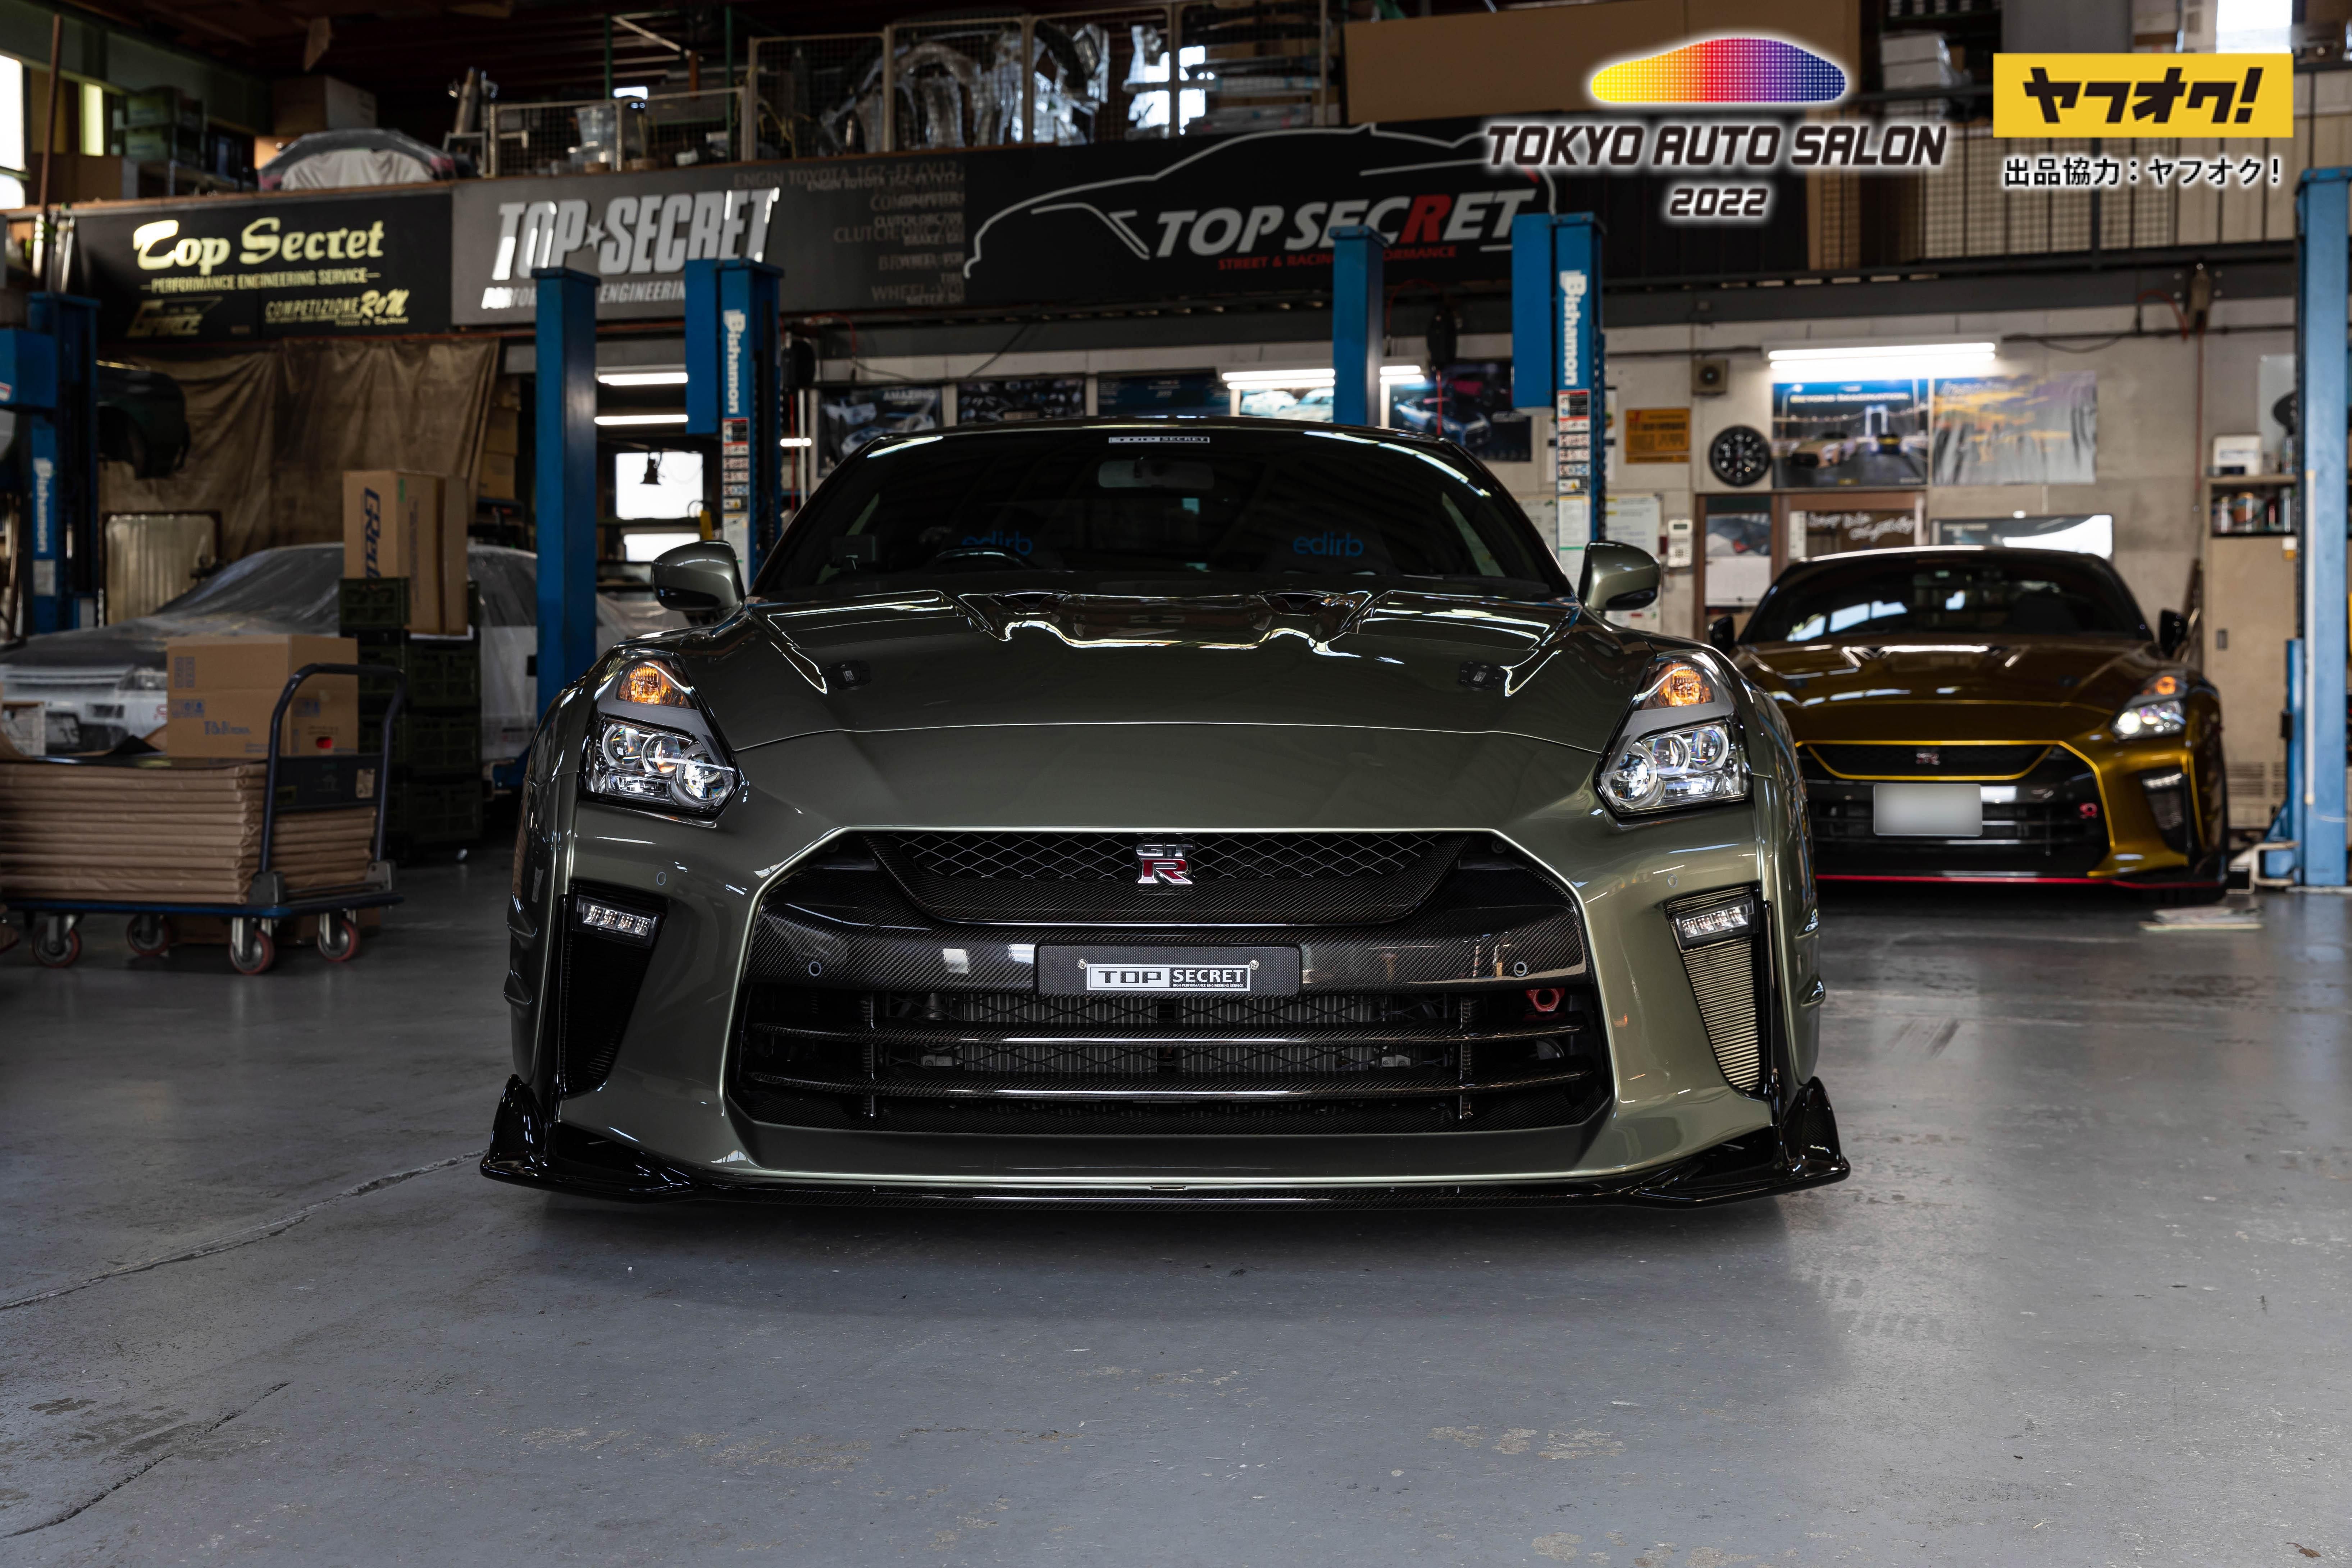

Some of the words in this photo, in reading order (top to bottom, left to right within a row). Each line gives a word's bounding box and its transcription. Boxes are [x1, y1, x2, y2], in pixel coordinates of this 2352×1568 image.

[492, 200, 588, 280] TOP
[598, 187, 780, 274] SECRET
[1157, 206, 1285, 257] TOP
[1285, 189, 1537, 251] SECRET
[133, 220, 231, 276] Top
[239, 217, 385, 265] Secret
[1218, 255, 1268, 270] STREET
[1287, 253, 1333, 267] RACIN
[1384, 246, 1458, 261] ORMANCE
[151, 274, 236, 293] PERFORMANCE
[238, 270, 316, 289] ENGINEERING
[318, 267, 368, 285] SERVICE
[600, 280, 685, 303] ENGINEERIN
[1560, 271, 1587, 387] Bishamon
[724, 309, 746, 414] Bishamon
[1293, 530, 1364, 557] edirb
[1098, 970, 1162, 984] TOP
[1173, 969, 1244, 982] SECRET
